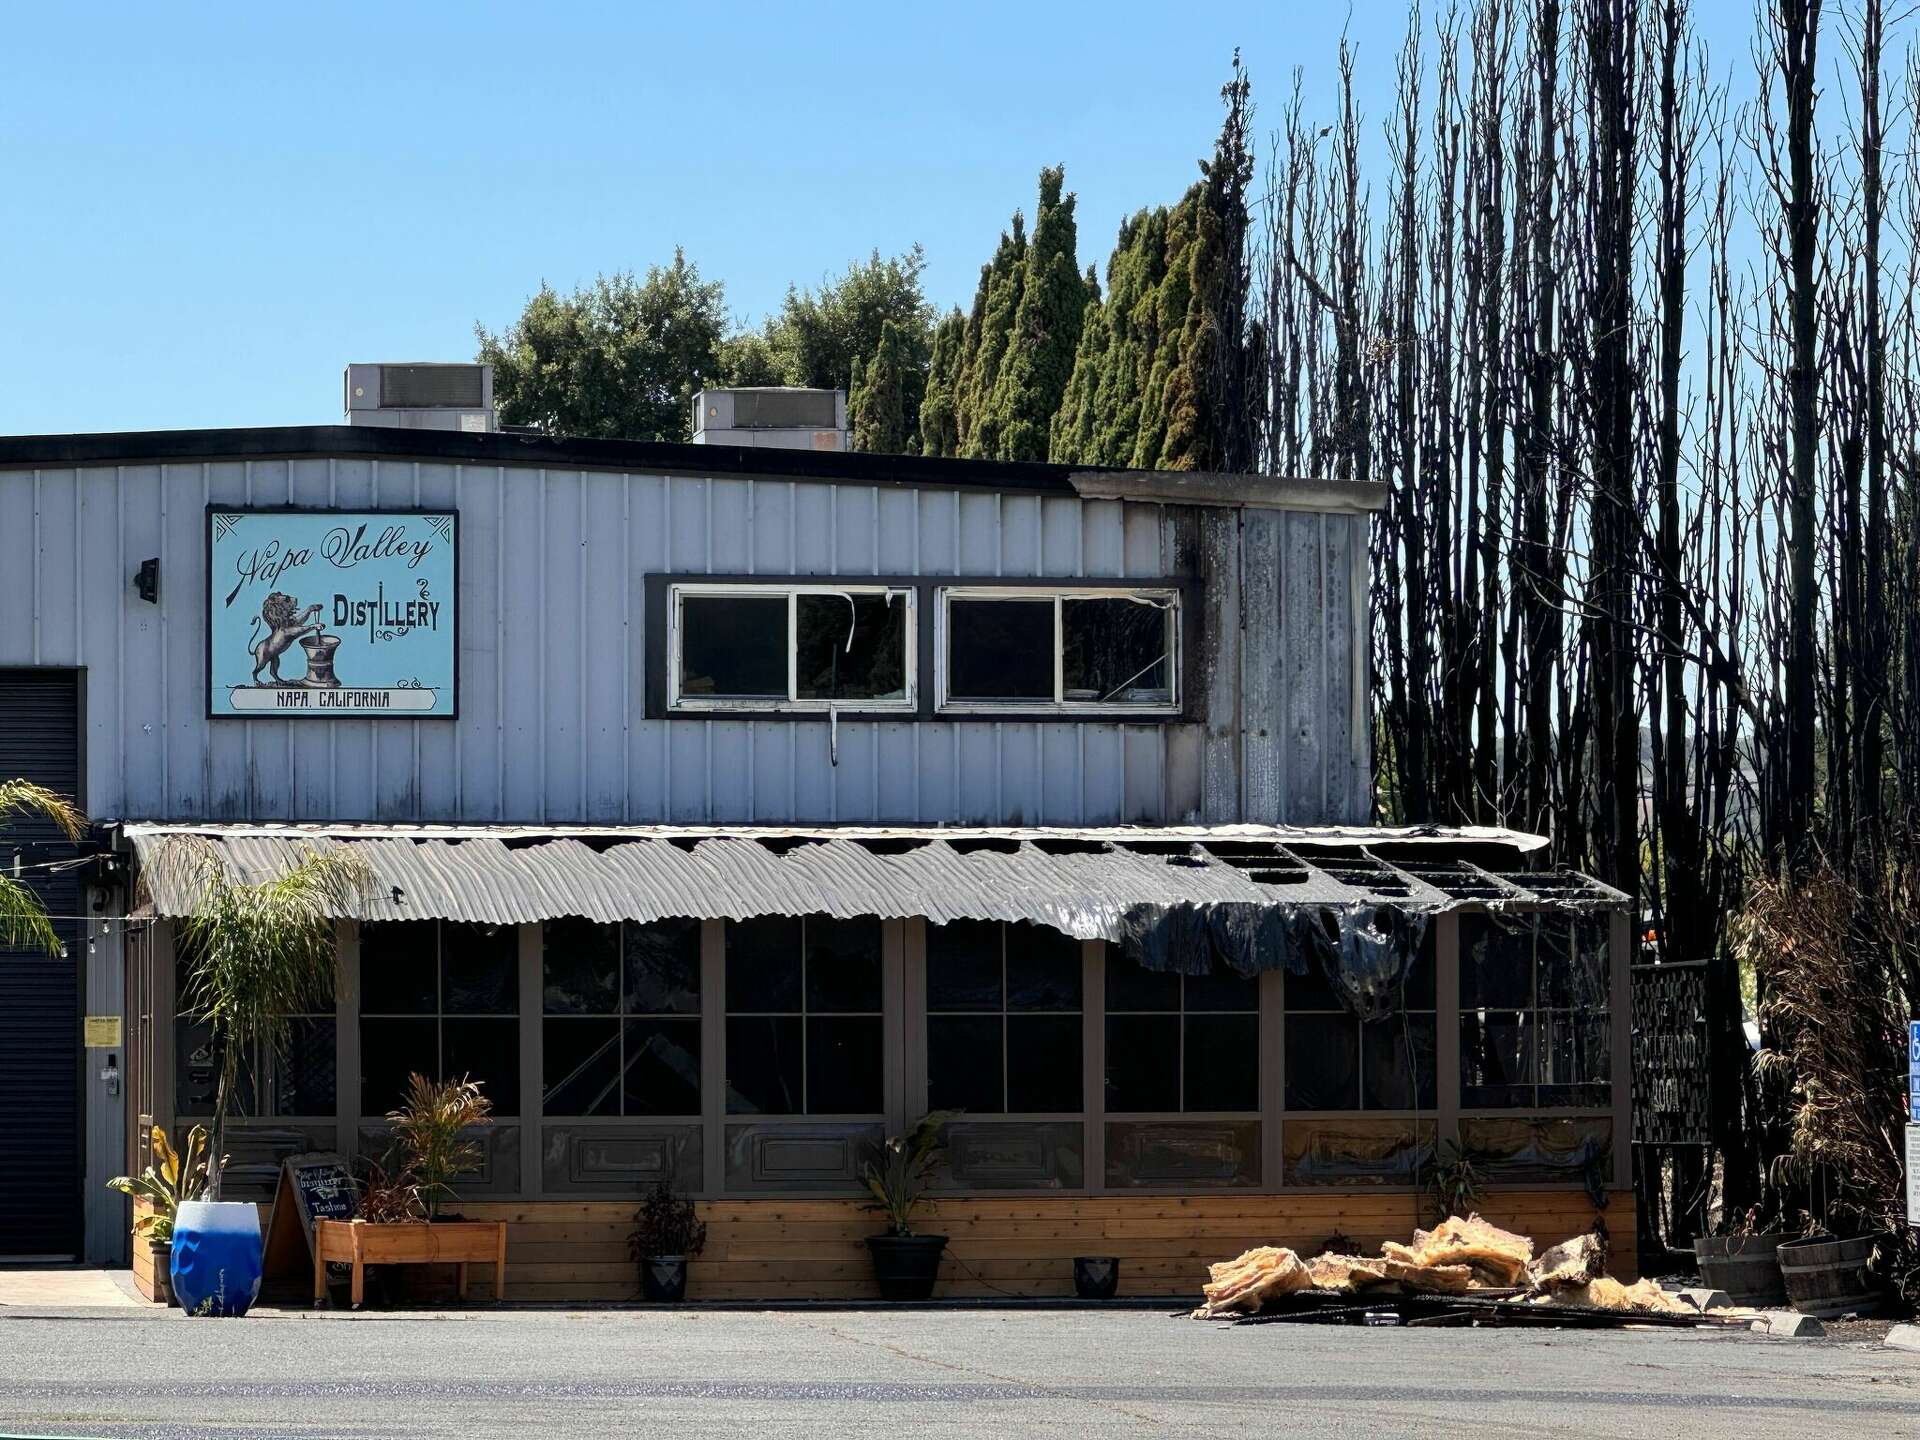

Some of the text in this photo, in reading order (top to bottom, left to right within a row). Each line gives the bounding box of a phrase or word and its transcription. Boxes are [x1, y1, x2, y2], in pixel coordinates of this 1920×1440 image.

[225, 523, 434, 608] Napa Valley
[277, 691, 390, 708] NAPA, CALIFORNIA
